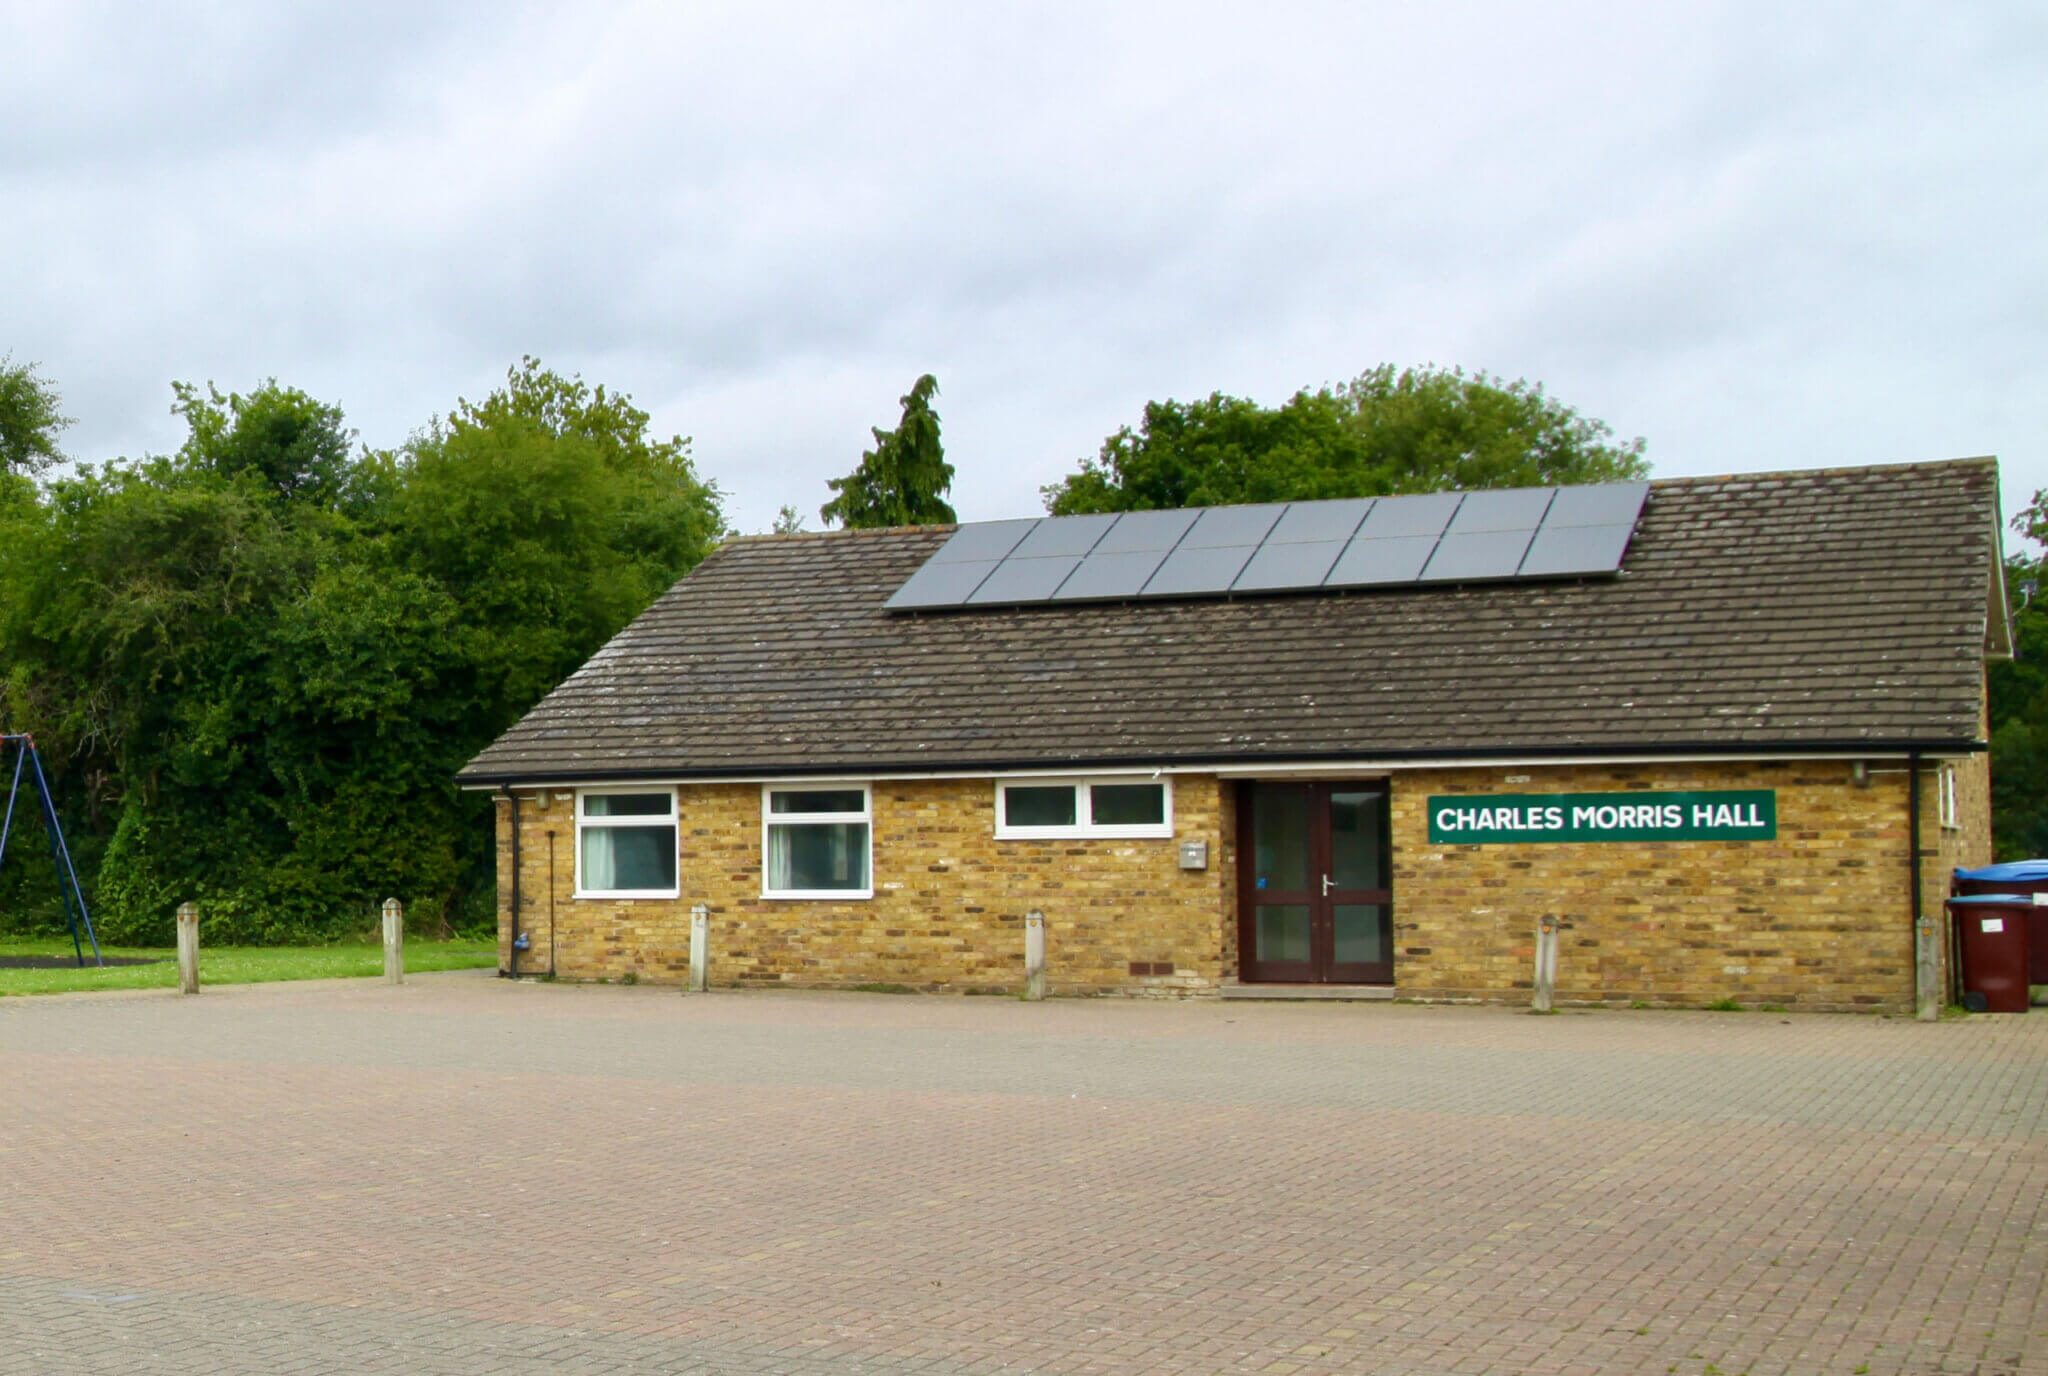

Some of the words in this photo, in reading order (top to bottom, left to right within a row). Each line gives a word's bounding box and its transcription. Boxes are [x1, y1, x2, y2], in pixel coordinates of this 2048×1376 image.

[1436, 807, 1563, 831] CHARLES
[1572, 804, 1682, 829] MORRIS
[1692, 803, 1765, 828] HALL
